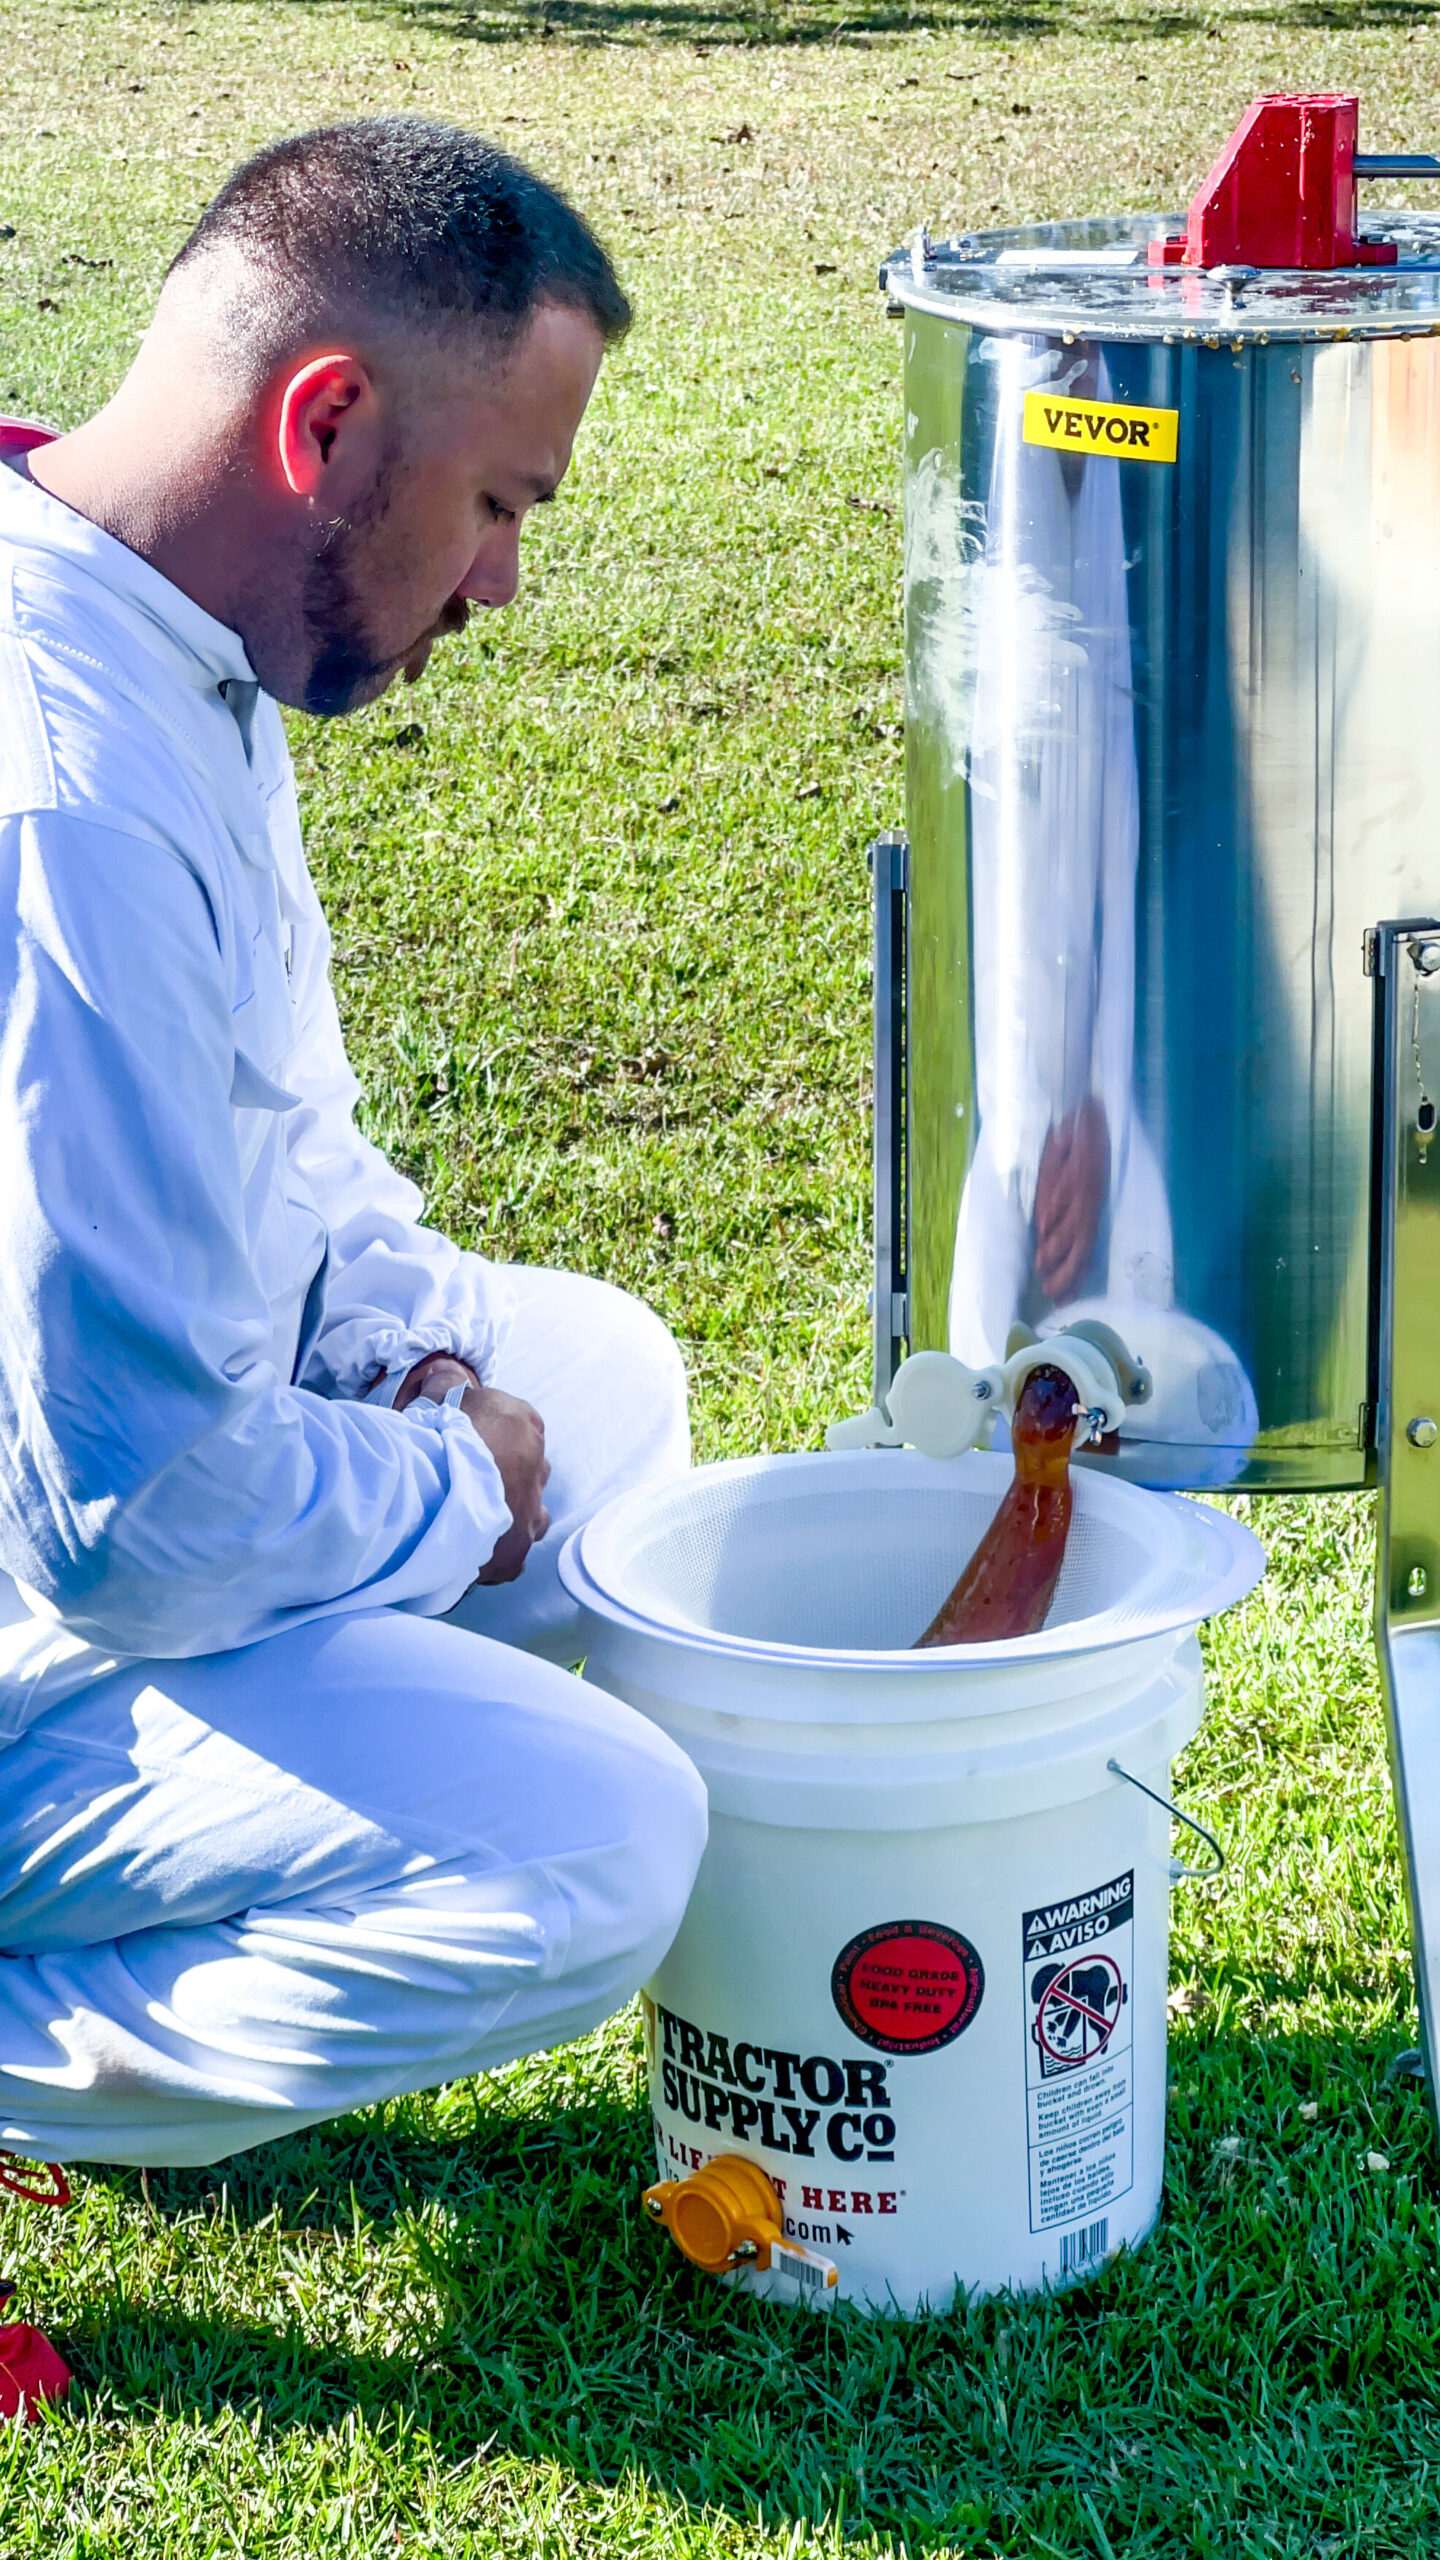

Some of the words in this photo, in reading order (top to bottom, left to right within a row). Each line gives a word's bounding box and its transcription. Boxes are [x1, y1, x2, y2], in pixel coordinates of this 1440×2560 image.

[1045, 1877, 1131, 1928] WARNING
[1049, 1915, 1109, 1954] AVISO
[861, 1963, 903, 1977] FOOD
[908, 1969, 959, 1981] GRADE
[860, 1980, 910, 1995] HEAVY
[916, 1987, 956, 1998] DUTY
[870, 1997, 898, 2010] BPA
[904, 2003, 941, 2014] FREE
[1037, 2085, 1071, 2100] Children
[1074, 2079, 1087, 2088] can
[1037, 2095, 1064, 2108] bucket
[1068, 2089, 1081, 2099] and
[662, 2058, 820, 2157] SUPPLY
[1039, 2111, 1059, 2120] Keep
[1062, 2098, 1092, 2113] children
[1095, 2088, 1111, 2100] away
[1039, 2116, 1066, 2130] bucket
[1069, 2110, 1084, 2120] with
[1087, 2102, 1103, 2113] even
[1039, 2124, 1069, 2139] amount
[1072, 2120, 1079, 2128] of
[669, 2134, 711, 2171] LIF
[1039, 2149, 1053, 2158] Los
[1079, 2131, 1100, 2144] corren
[1040, 2159, 1049, 2167] de
[1052, 2151, 1076, 2163] caerse
[1079, 2140, 1100, 2153] dentro
[1040, 2172, 1076, 2188] Mantener
[1086, 2163, 1096, 2172] los
[1040, 2186, 1060, 2196] lejos
[1063, 2182, 1072, 2190] de
[1075, 2178, 1085, 2186] los
[1041, 2192, 1070, 2205] incluso
[1072, 2179, 1098, 2195] cuando
[1041, 2201, 1068, 2214] tengan
[1071, 2195, 1084, 2204] una
[1041, 2206, 1075, 2223] cantidad
[1077, 2202, 1086, 2210] de
